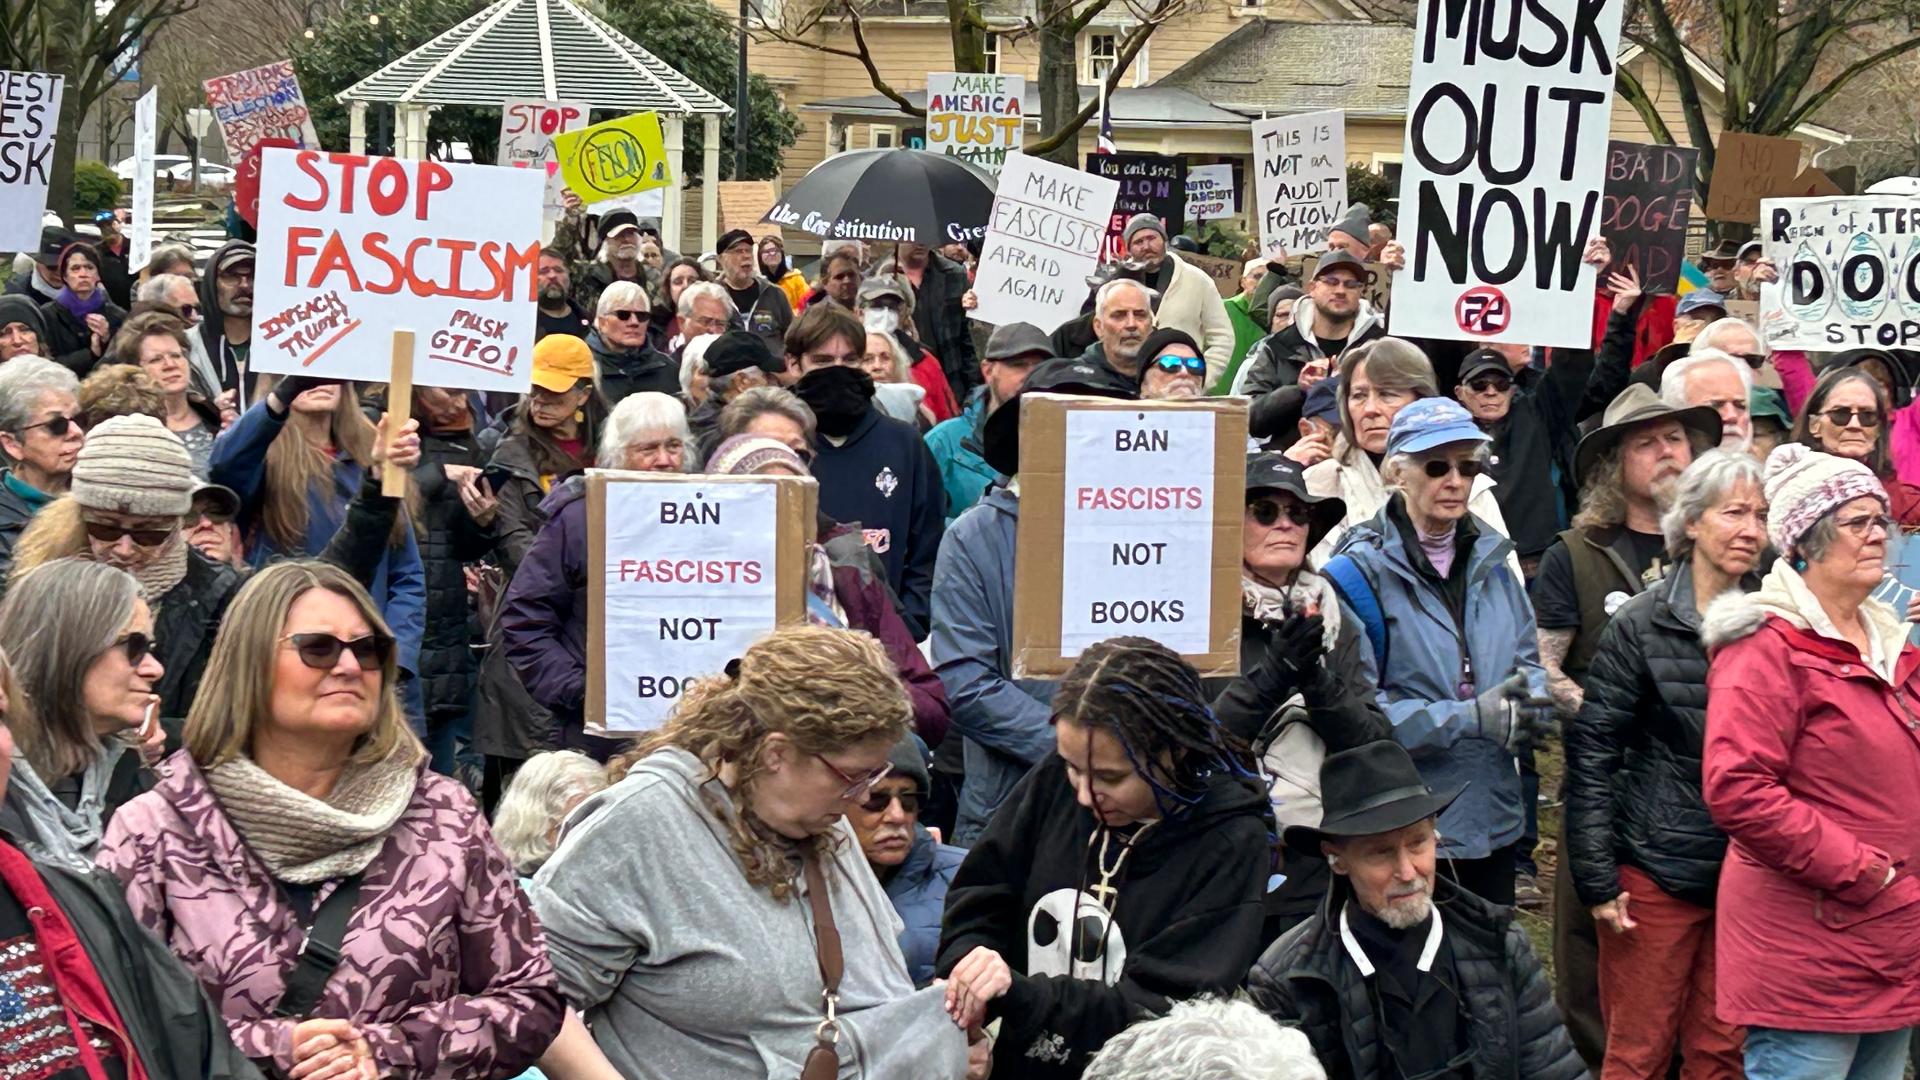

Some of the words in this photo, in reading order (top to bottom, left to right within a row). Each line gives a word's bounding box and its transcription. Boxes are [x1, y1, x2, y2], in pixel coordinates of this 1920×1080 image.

[1423, 0, 1612, 75] MUSK
[952, 76, 1006, 94] MAKE
[929, 95, 1020, 115] AMERICA
[506, 105, 580, 135] STOP
[929, 113, 1021, 145] JUST
[1411, 82, 1605, 185] OUT
[1261, 130, 1300, 152] THIS
[1313, 125, 1330, 144] IS
[945, 145, 1008, 165] AGAIN
[1264, 154, 1302, 178] NOT
[1608, 150, 1683, 185] BAD
[283, 151, 453, 221] STOP
[1024, 172, 1094, 212] MAKE
[1275, 178, 1340, 204] AUDIT
[994, 201, 1101, 253] FASCISTS
[1266, 201, 1341, 233] FOLLOW
[1838, 211, 1858, 234] of
[1413, 180, 1599, 291] NOW
[284, 227, 541, 302] FASCISM
[988, 245, 1060, 277] AFRAID
[999, 277, 1064, 305] AGAIN
[449, 309, 508, 340] MUSK
[1825, 319, 1920, 346] STOP
[431, 330, 518, 372] GTFO!
[1115, 429, 1169, 451] BAN
[1077, 487, 1203, 510] FASCISTS
[660, 502, 720, 524] BAN
[1112, 543, 1167, 566] NOT
[620, 559, 762, 584] FASCISTS
[1091, 600, 1185, 624] BOOKS
[659, 618, 722, 641] NOT
